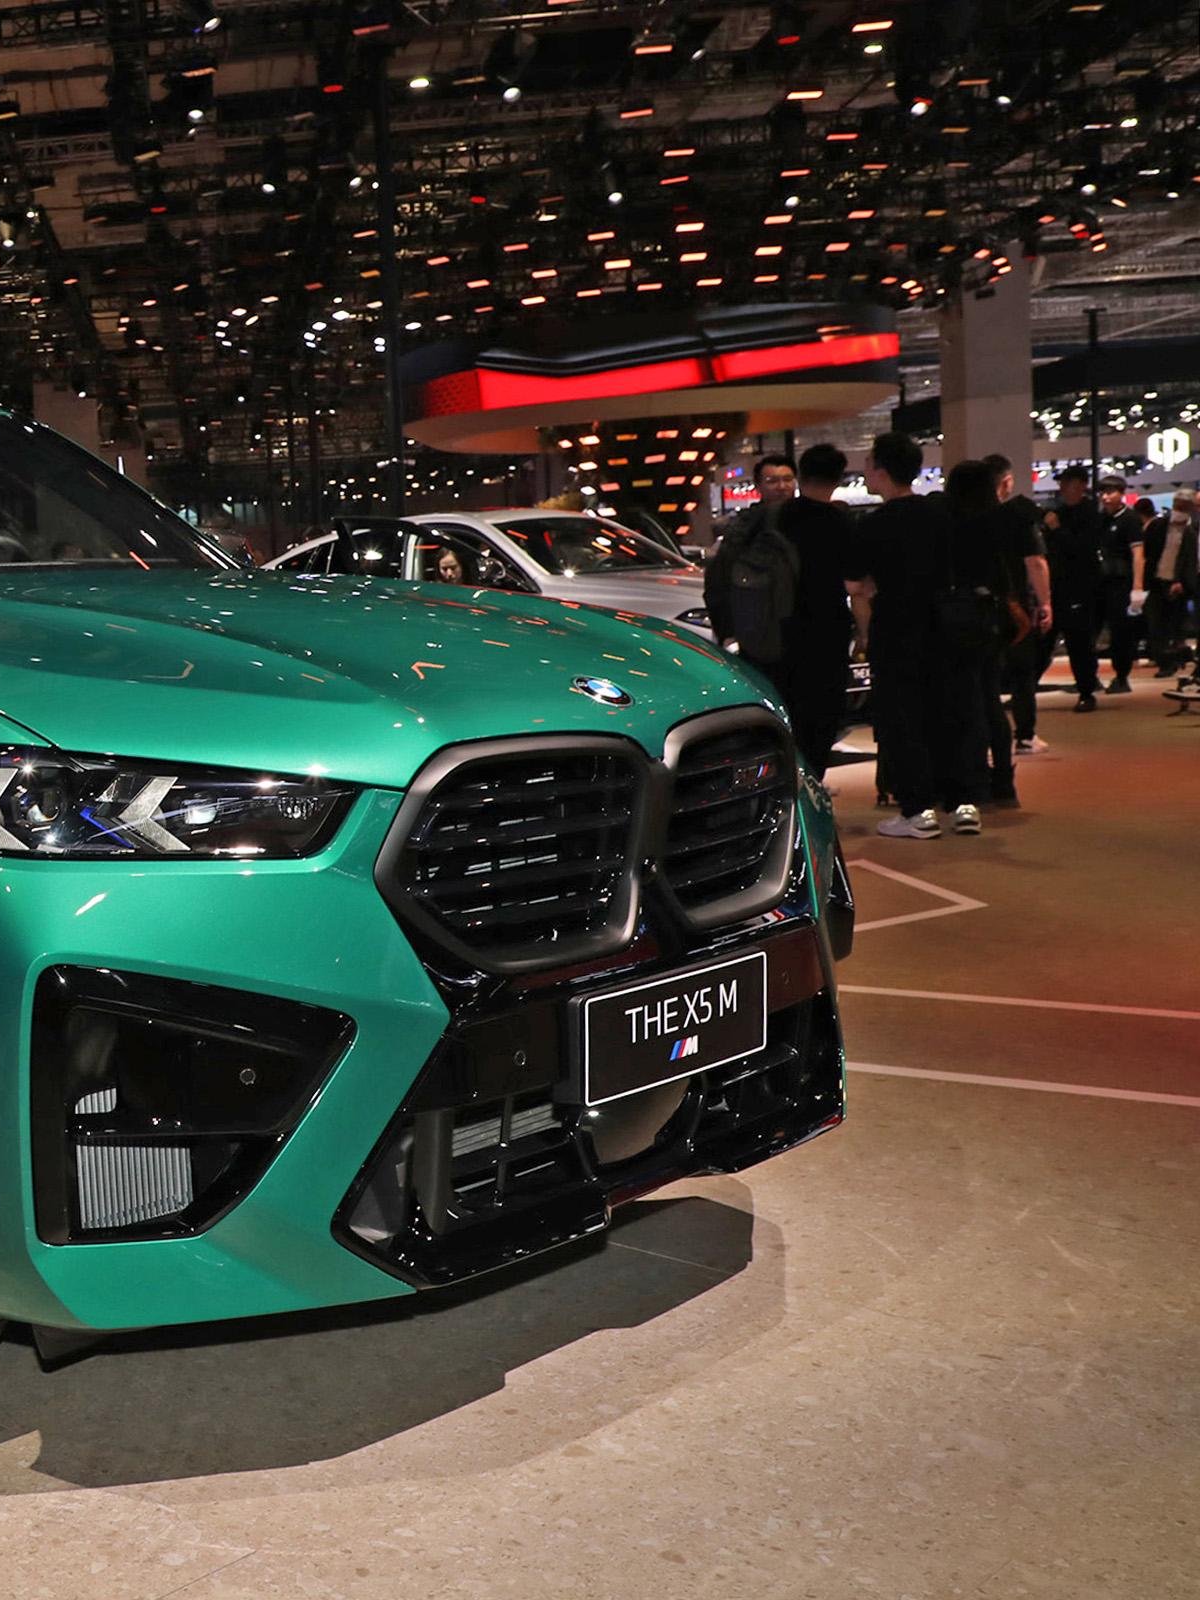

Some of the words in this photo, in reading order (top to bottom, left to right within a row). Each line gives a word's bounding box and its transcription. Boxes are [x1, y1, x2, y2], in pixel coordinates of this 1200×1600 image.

[625, 997, 679, 1043] THE
[683, 987, 713, 1029] X5
[719, 979, 737, 1017] M
